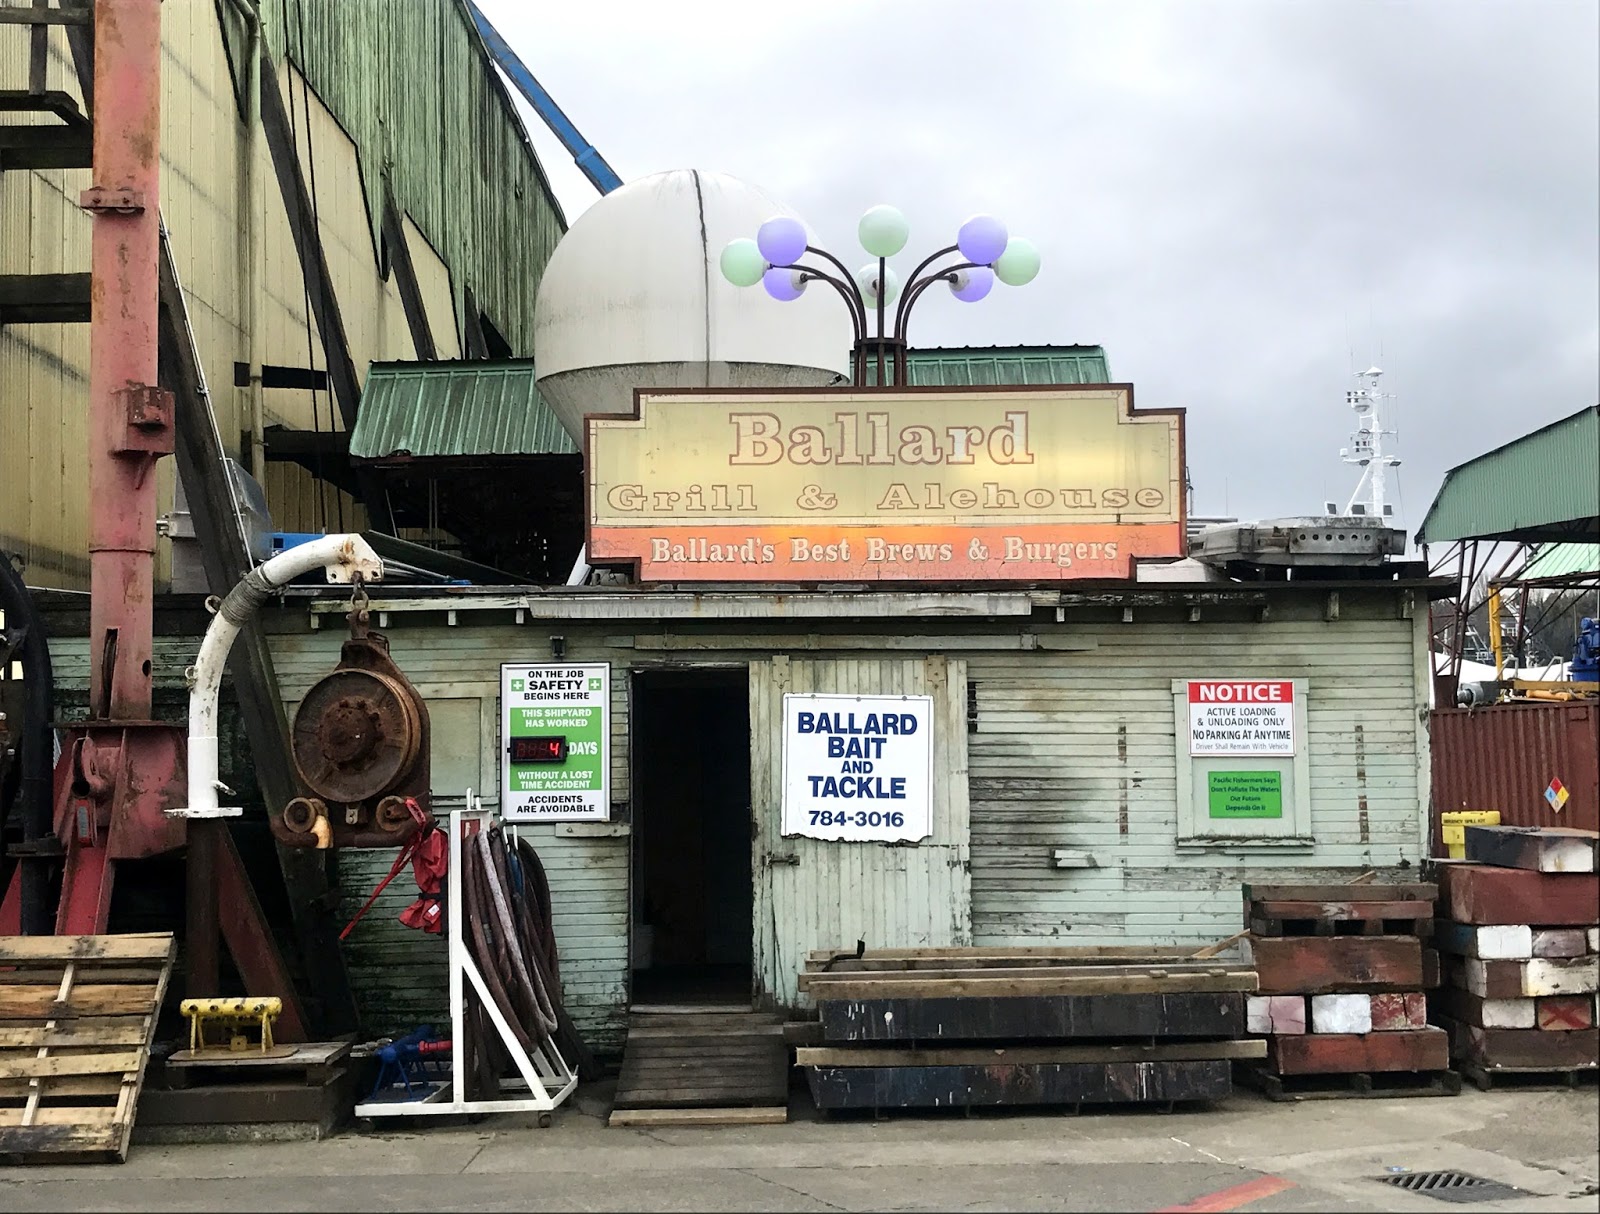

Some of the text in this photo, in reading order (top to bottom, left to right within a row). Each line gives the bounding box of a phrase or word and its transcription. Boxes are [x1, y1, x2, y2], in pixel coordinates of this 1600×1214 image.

[729, 411, 1035, 466] Ballard
[607, 482, 1164, 511] Grill & Alehouse
[651, 537, 1118, 568] Ballard's Best Brews & Burgers
[528, 680, 584, 690] SAFETY
[1199, 684, 1282, 701] NOTICE
[522, 708, 592, 718] THIS SHIPYARD
[1207, 708, 1276, 716] ACTIVE LOADING
[526, 719, 588, 728] HAS WORKED
[798, 712, 918, 735] BALLARD
[1198, 718, 1285, 726] & UNLOADING ONLY
[1206, 729, 1240, 740] PARKING
[1242, 729, 1252, 740] AT
[568, 741, 598, 756] DAYS
[828, 736, 887, 758] BAIT
[841, 760, 874, 774] AND
[518, 770, 594, 780] WITHOUT A LOST
[520, 780, 590, 789] TIME ACCIDENT
[808, 776, 906, 798] TACKLE
[528, 796, 583, 804] ACCIDENTS
[516, 804, 594, 813] ARE AVOIDABLE
[808, 810, 904, 827] 784-3016
